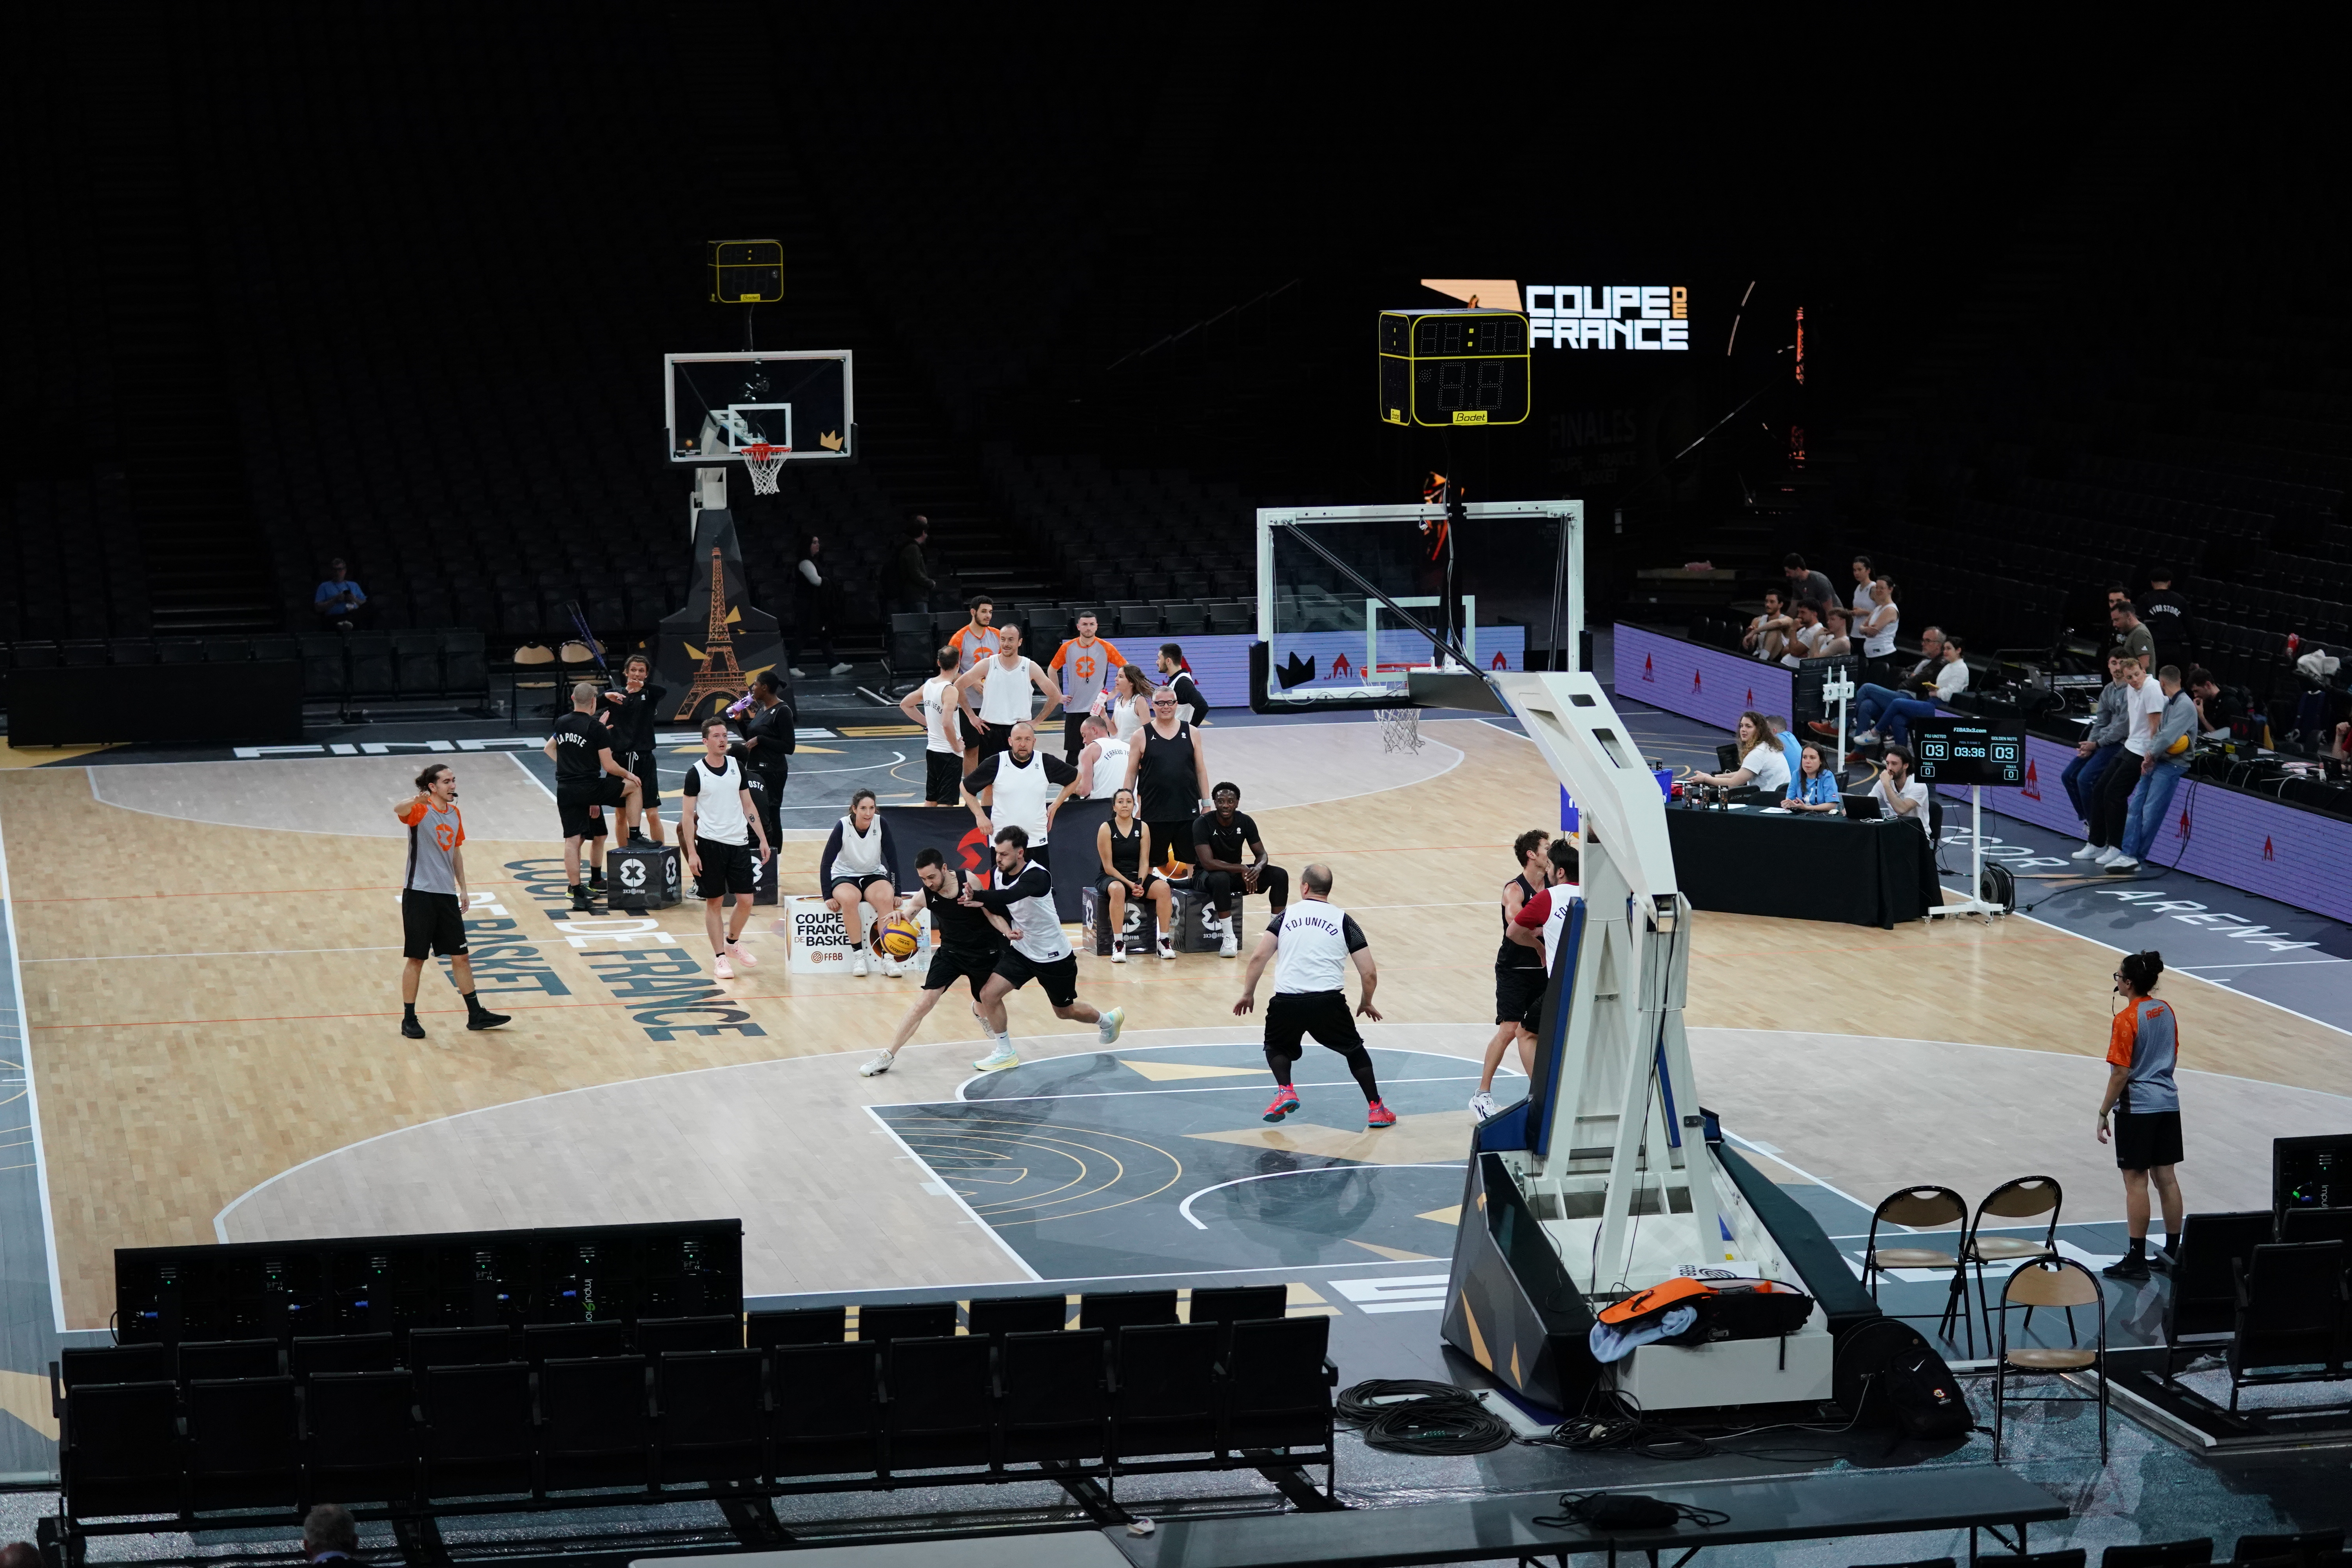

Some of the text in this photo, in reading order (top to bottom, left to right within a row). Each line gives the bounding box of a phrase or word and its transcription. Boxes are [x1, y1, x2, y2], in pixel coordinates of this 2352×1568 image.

[1526, 286, 1670, 318] COUPE
[1530, 319, 1689, 350] FRANCE
[1455, 413, 1486, 422] Bodet
[557, 732, 587, 748] LA POSTE
[1104, 749, 1123, 760] FERRERO
[1926, 744, 1944, 757] 03
[1954, 747, 1985, 757] 03:36
[1995, 747, 2014, 759] 03
[748, 780, 764, 791] OSTE
[796, 913, 844, 924] COUPE
[2096, 890, 2321, 952] ARENA
[798, 924, 848, 935] FRANC
[1285, 917, 1338, 936] FDJ UNITED
[553, 918, 676, 948] DE
[806, 936, 851, 946] BASKE
[824, 953, 843, 961] FFBB
[579, 948, 768, 1042] FRANCE
[2146, 1005, 2165, 1020] REF
[1678, 1265, 1697, 1276] FFBB
